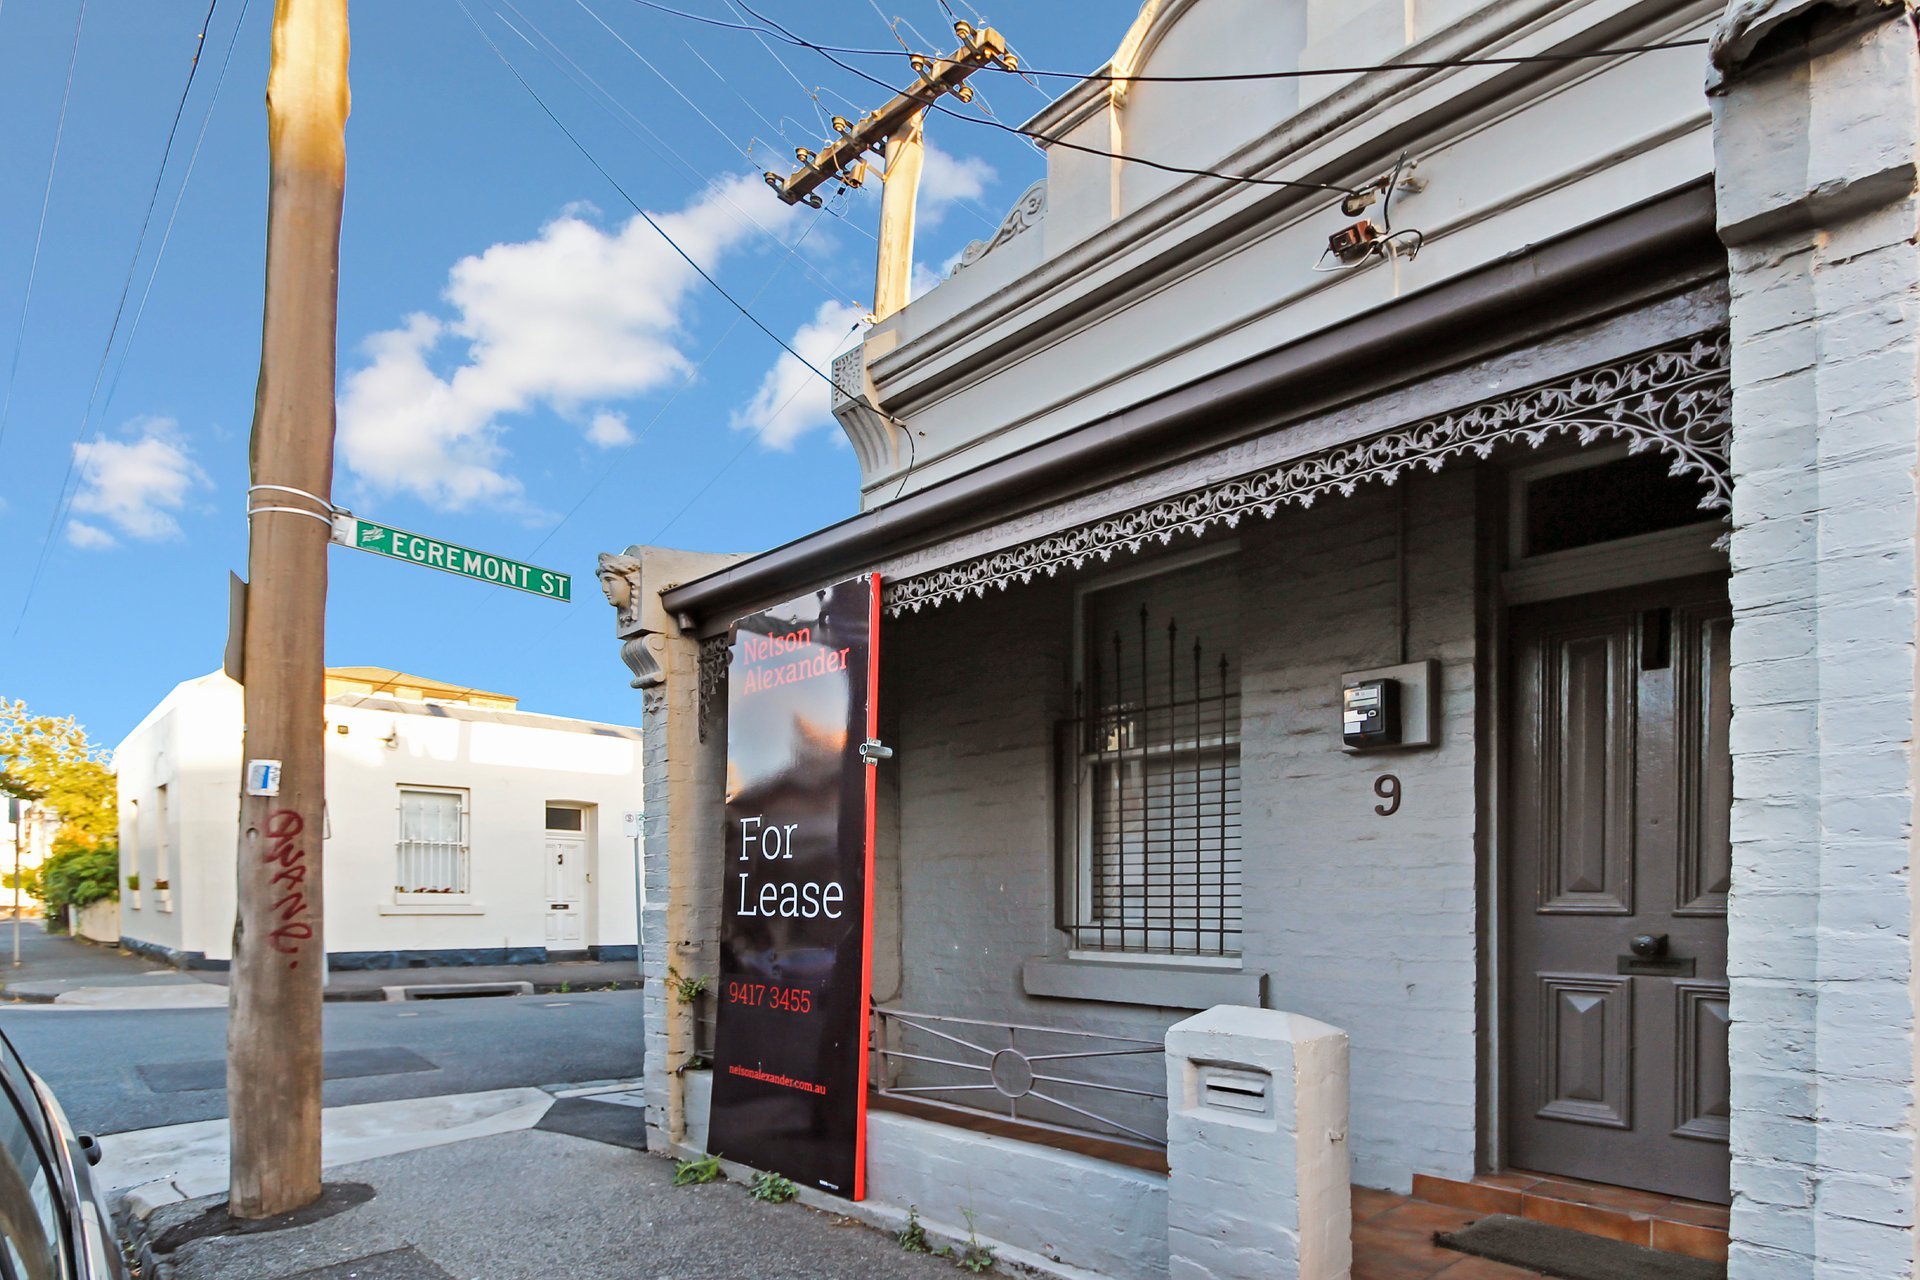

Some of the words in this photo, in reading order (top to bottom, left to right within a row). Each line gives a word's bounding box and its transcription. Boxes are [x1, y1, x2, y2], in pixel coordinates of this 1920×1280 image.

[391, 532, 532, 587] EGREMONT
[540, 573, 567, 597] ST
[743, 627, 812, 666] Nelson
[743, 646, 850, 696] Alexander
[1374, 774, 1401, 816] 9
[739, 817, 798, 861] For
[737, 873, 844, 919] Lease
[729, 982, 766, 1006] 9417
[769, 986, 811, 1013] 3455
[729, 1065, 826, 1095] nelsonalexander.com.au
